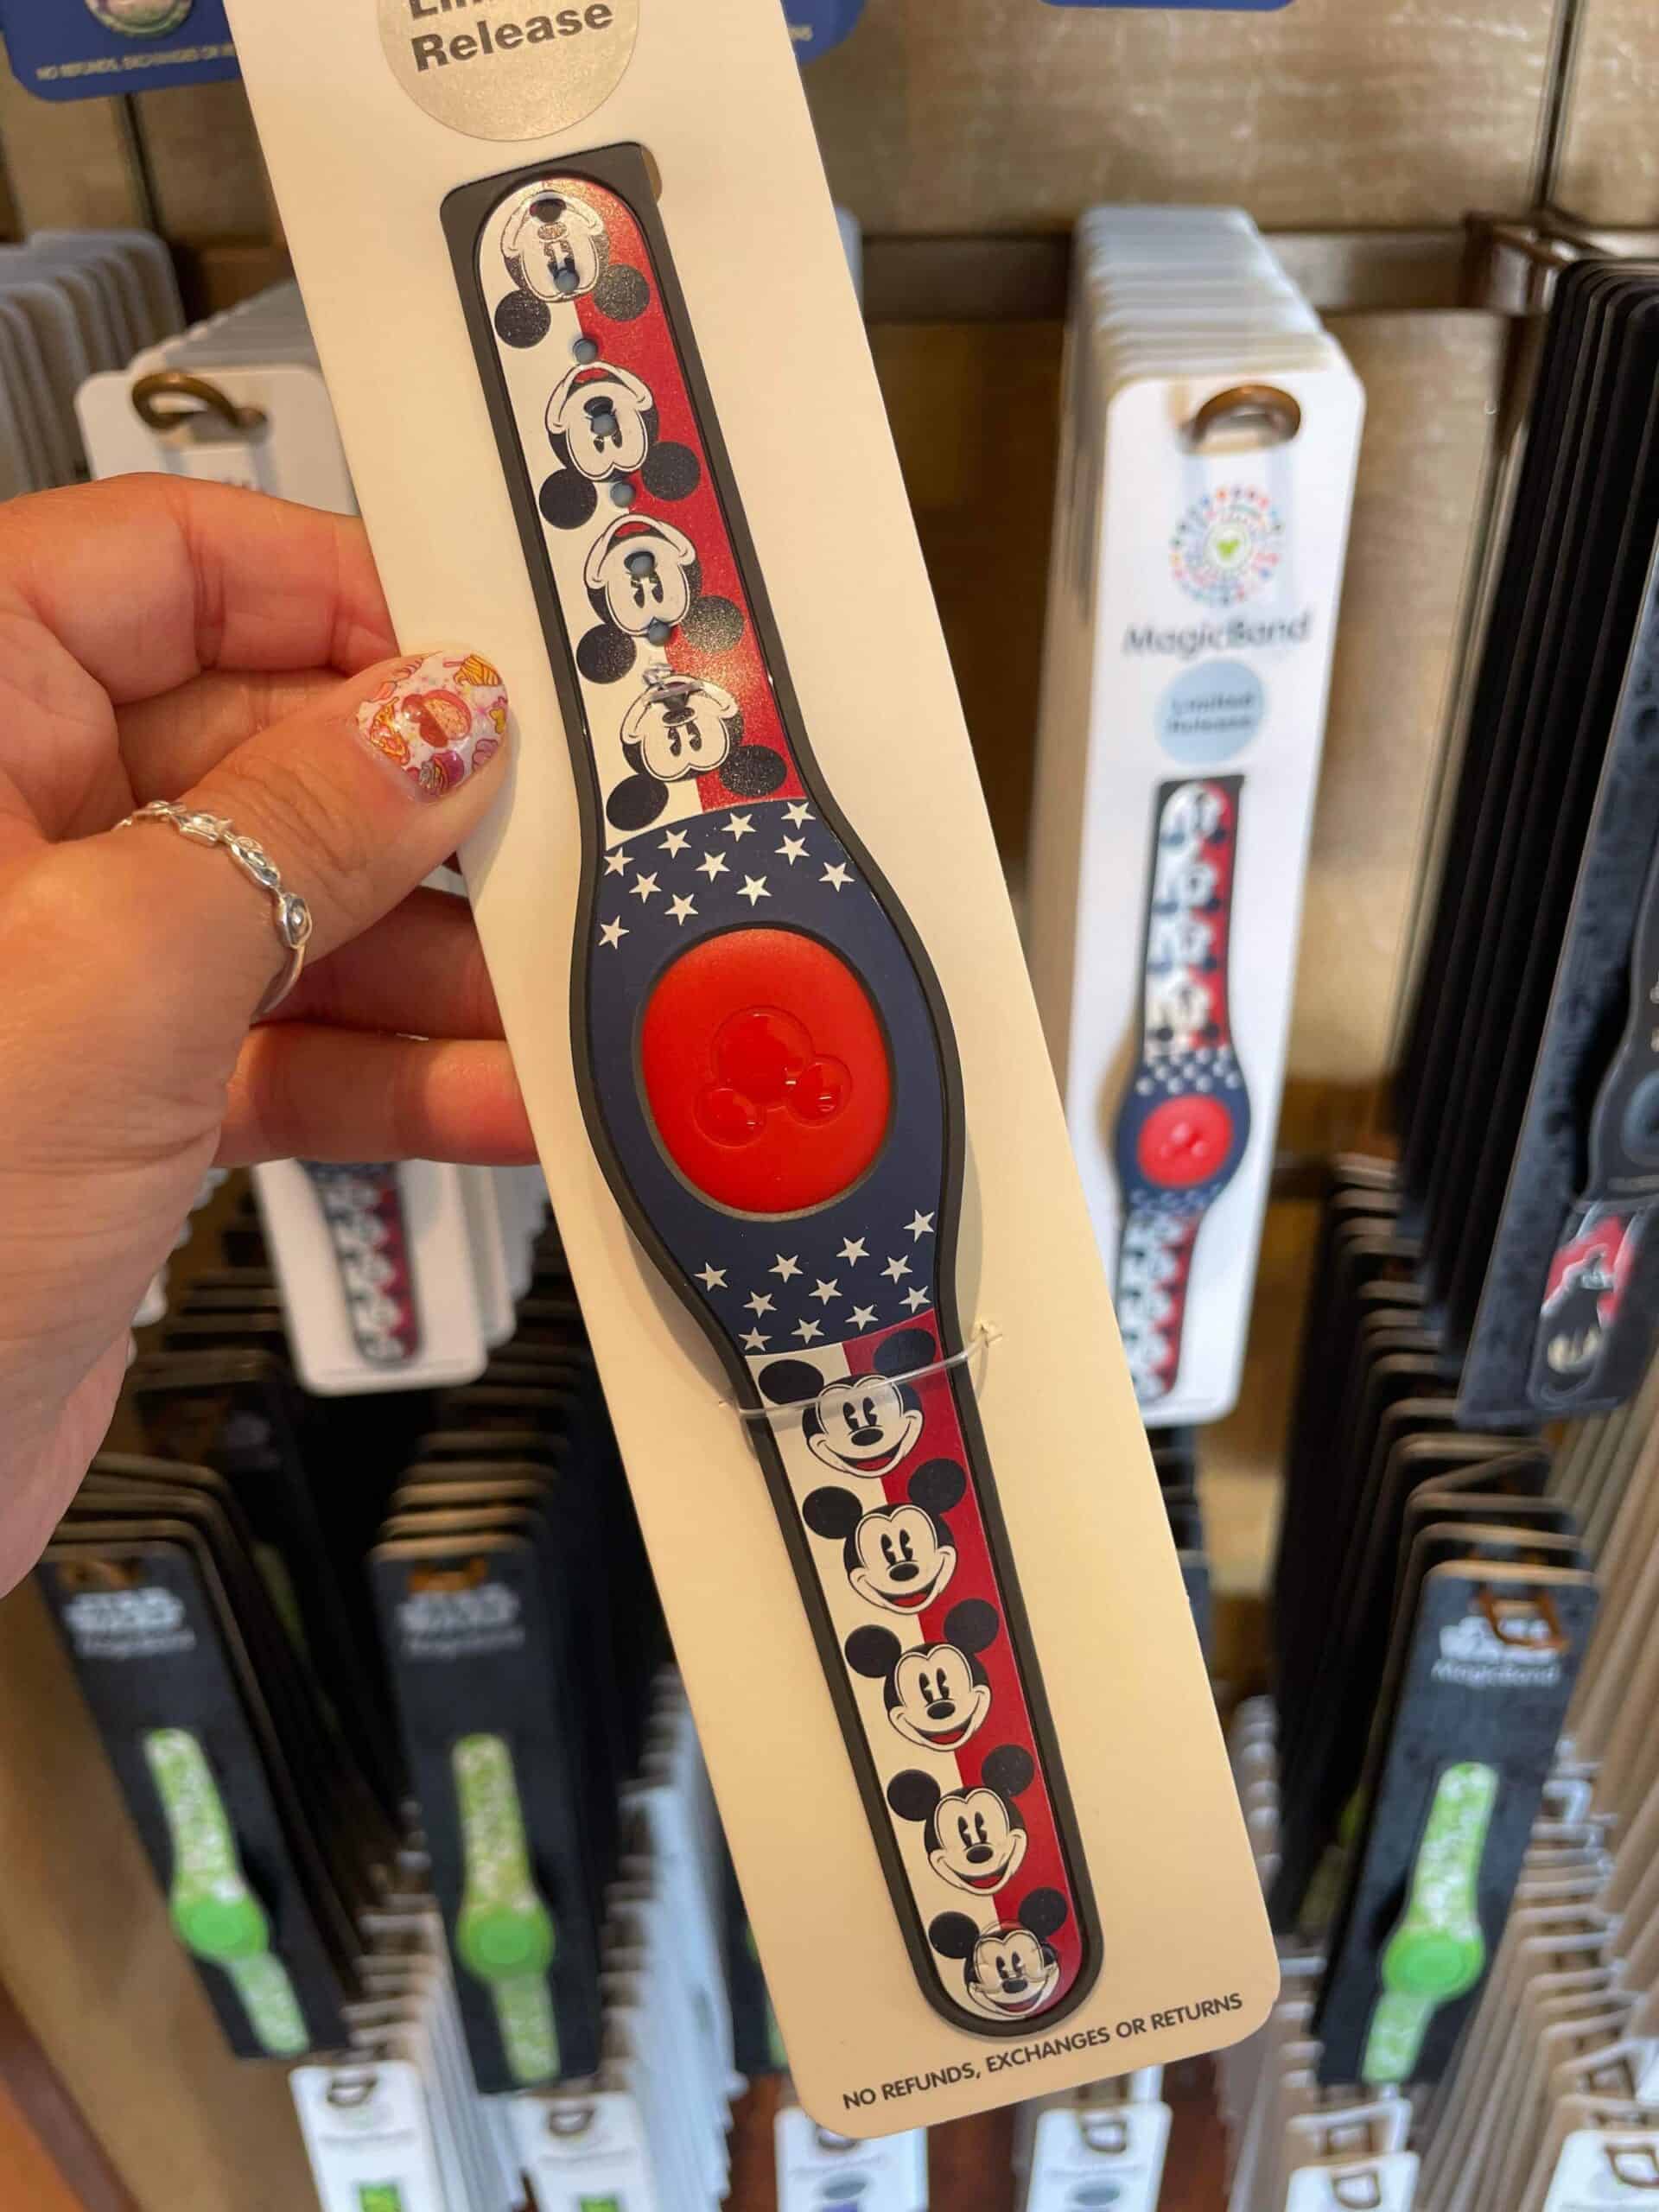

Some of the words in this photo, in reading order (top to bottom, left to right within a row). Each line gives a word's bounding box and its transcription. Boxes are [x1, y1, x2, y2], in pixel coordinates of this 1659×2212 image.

[410, 3, 613, 72] Release
[842, 2088, 877, 2109] NO
[881, 2062, 982, 2098] REFUNDS,
[985, 2027, 1110, 2073] EXCHANGES
[1116, 2018, 1146, 2038] OR
[1151, 1993, 1243, 2029] RETURNS
